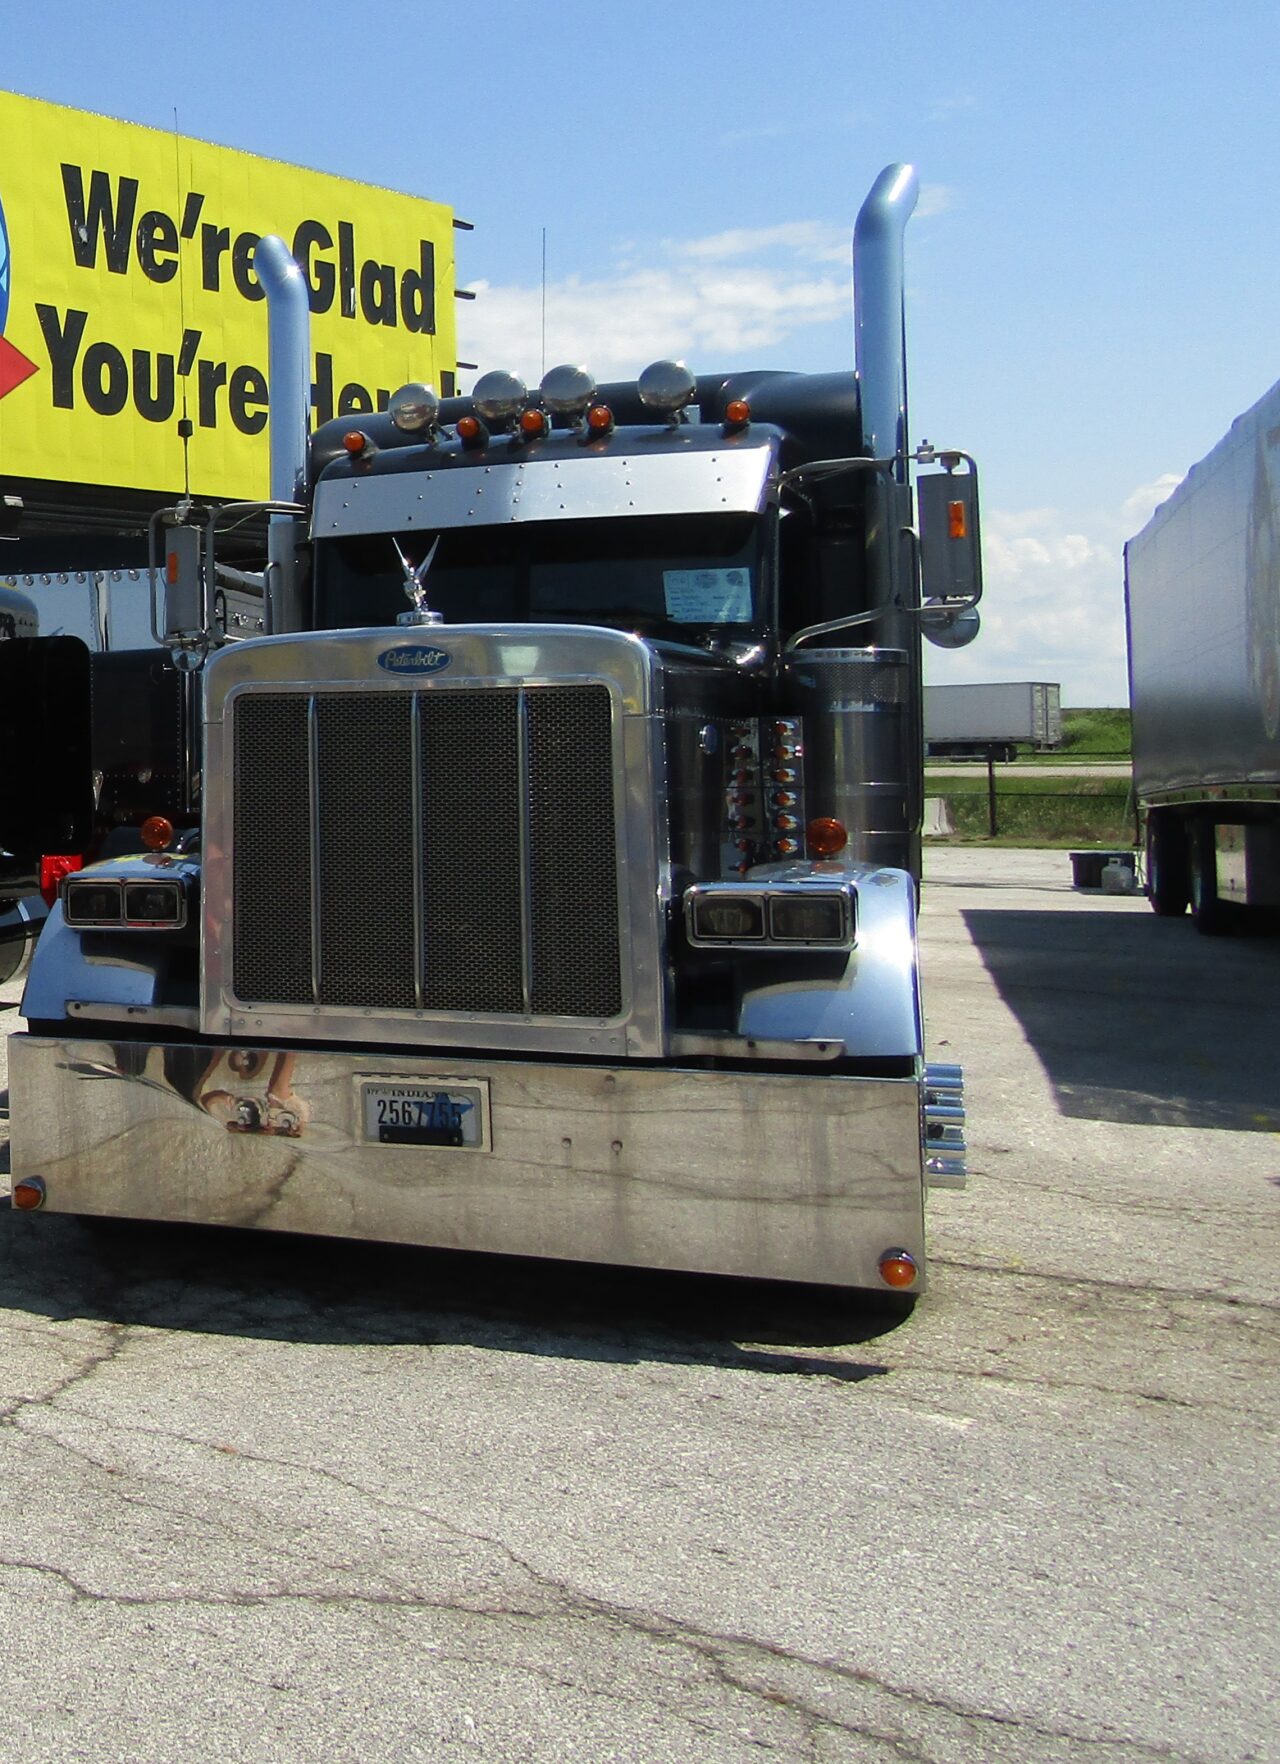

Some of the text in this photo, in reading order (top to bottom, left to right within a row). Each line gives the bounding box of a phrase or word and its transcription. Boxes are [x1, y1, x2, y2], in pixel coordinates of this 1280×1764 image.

[60, 163, 436, 335] We're Glad
[35, 303, 269, 435] You're
